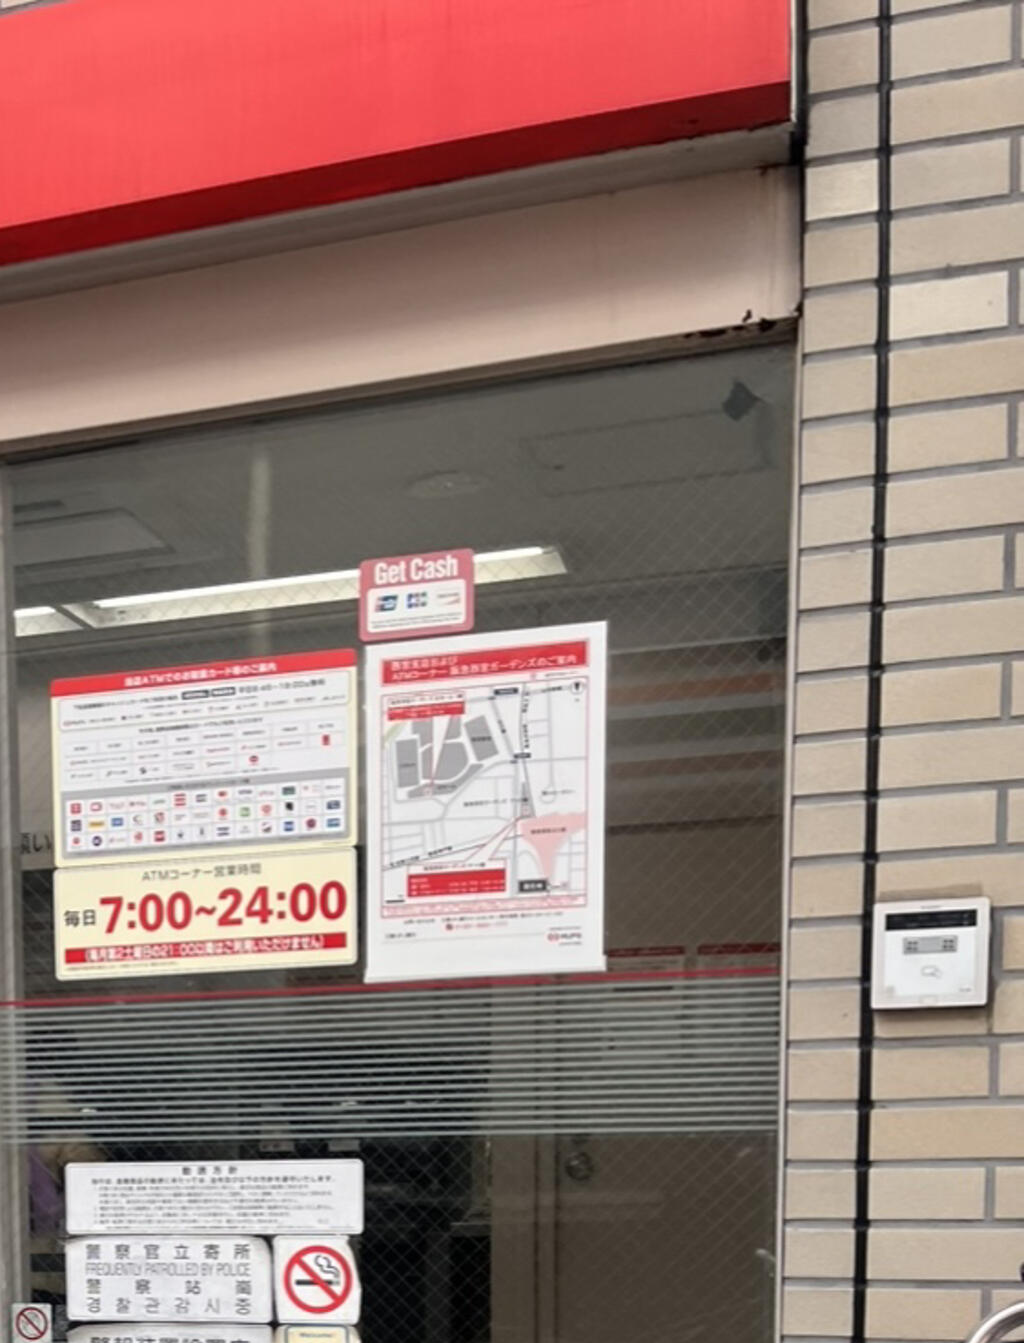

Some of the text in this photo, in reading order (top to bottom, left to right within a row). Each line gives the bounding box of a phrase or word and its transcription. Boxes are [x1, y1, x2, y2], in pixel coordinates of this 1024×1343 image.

[374, 554, 458, 586] Get Cash
[142, 863, 262, 881] ATMコーナー営業時間
[64, 909, 97, 927] 毎日
[86, 1243, 250, 1260] 警察官立寄所
[85, 1262, 251, 1276] FREQUENTLY PATROLLED BY POLICE
